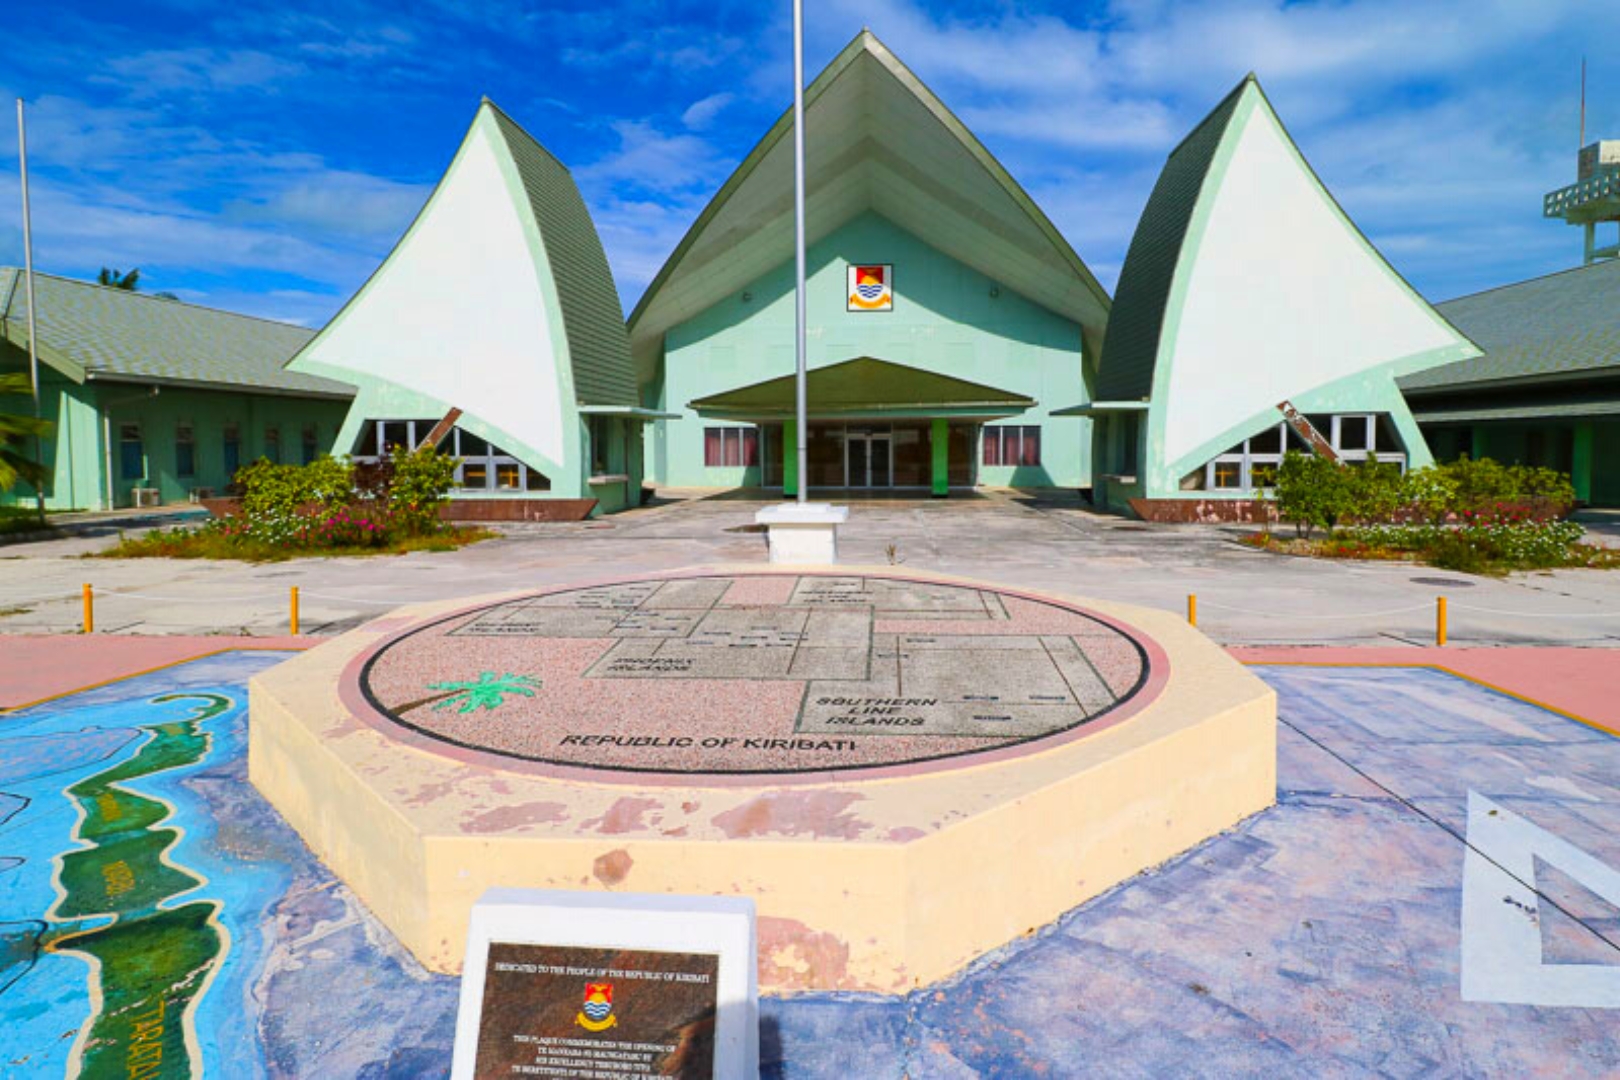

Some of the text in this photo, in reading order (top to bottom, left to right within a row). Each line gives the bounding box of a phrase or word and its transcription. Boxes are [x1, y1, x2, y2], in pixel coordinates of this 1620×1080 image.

[816, 697, 938, 706] SOUTHERN
[848, 706, 902, 715] LINE
[825, 716, 926, 726] ISLANDS
[559, 734, 856, 751] REPUBLIC OF KIRIBATI
[625, 969, 662, 980] REPUBLIC
